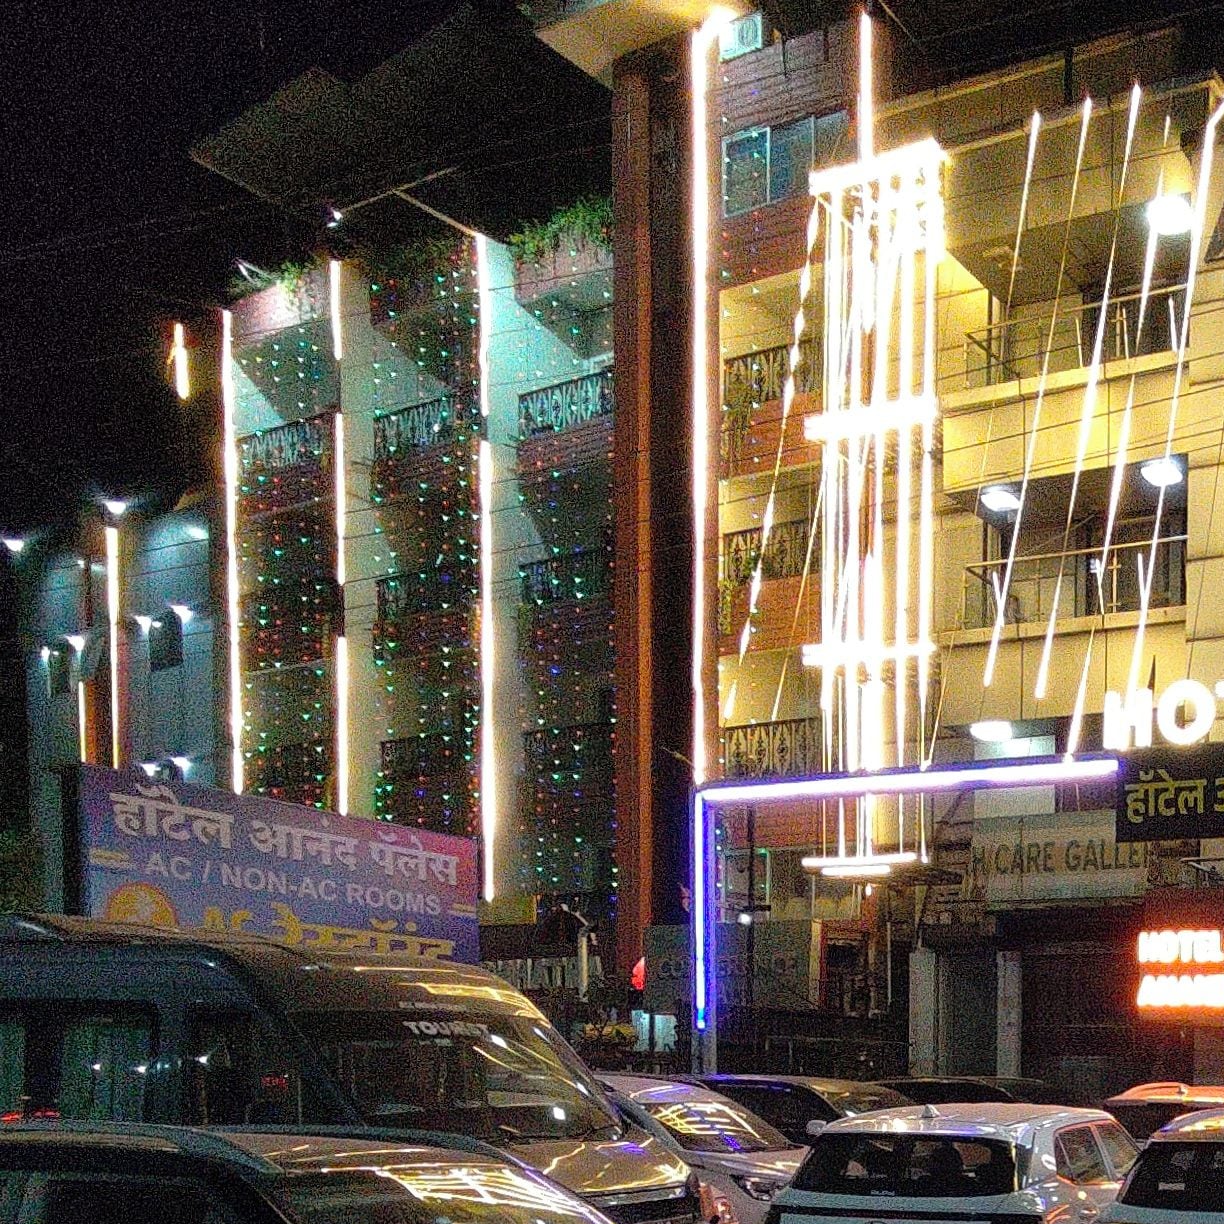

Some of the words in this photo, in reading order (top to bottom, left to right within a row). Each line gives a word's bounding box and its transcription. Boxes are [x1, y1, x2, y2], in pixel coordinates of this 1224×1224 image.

[109, 783, 236, 849] हॉटेल
[250, 815, 359, 868] आनंद
[1125, 769, 1205, 823] हॉटेल
[147, 854, 192, 881] AC
[221, 862, 339, 902] NON-AC
[346, 882, 443, 916] ROOMS
